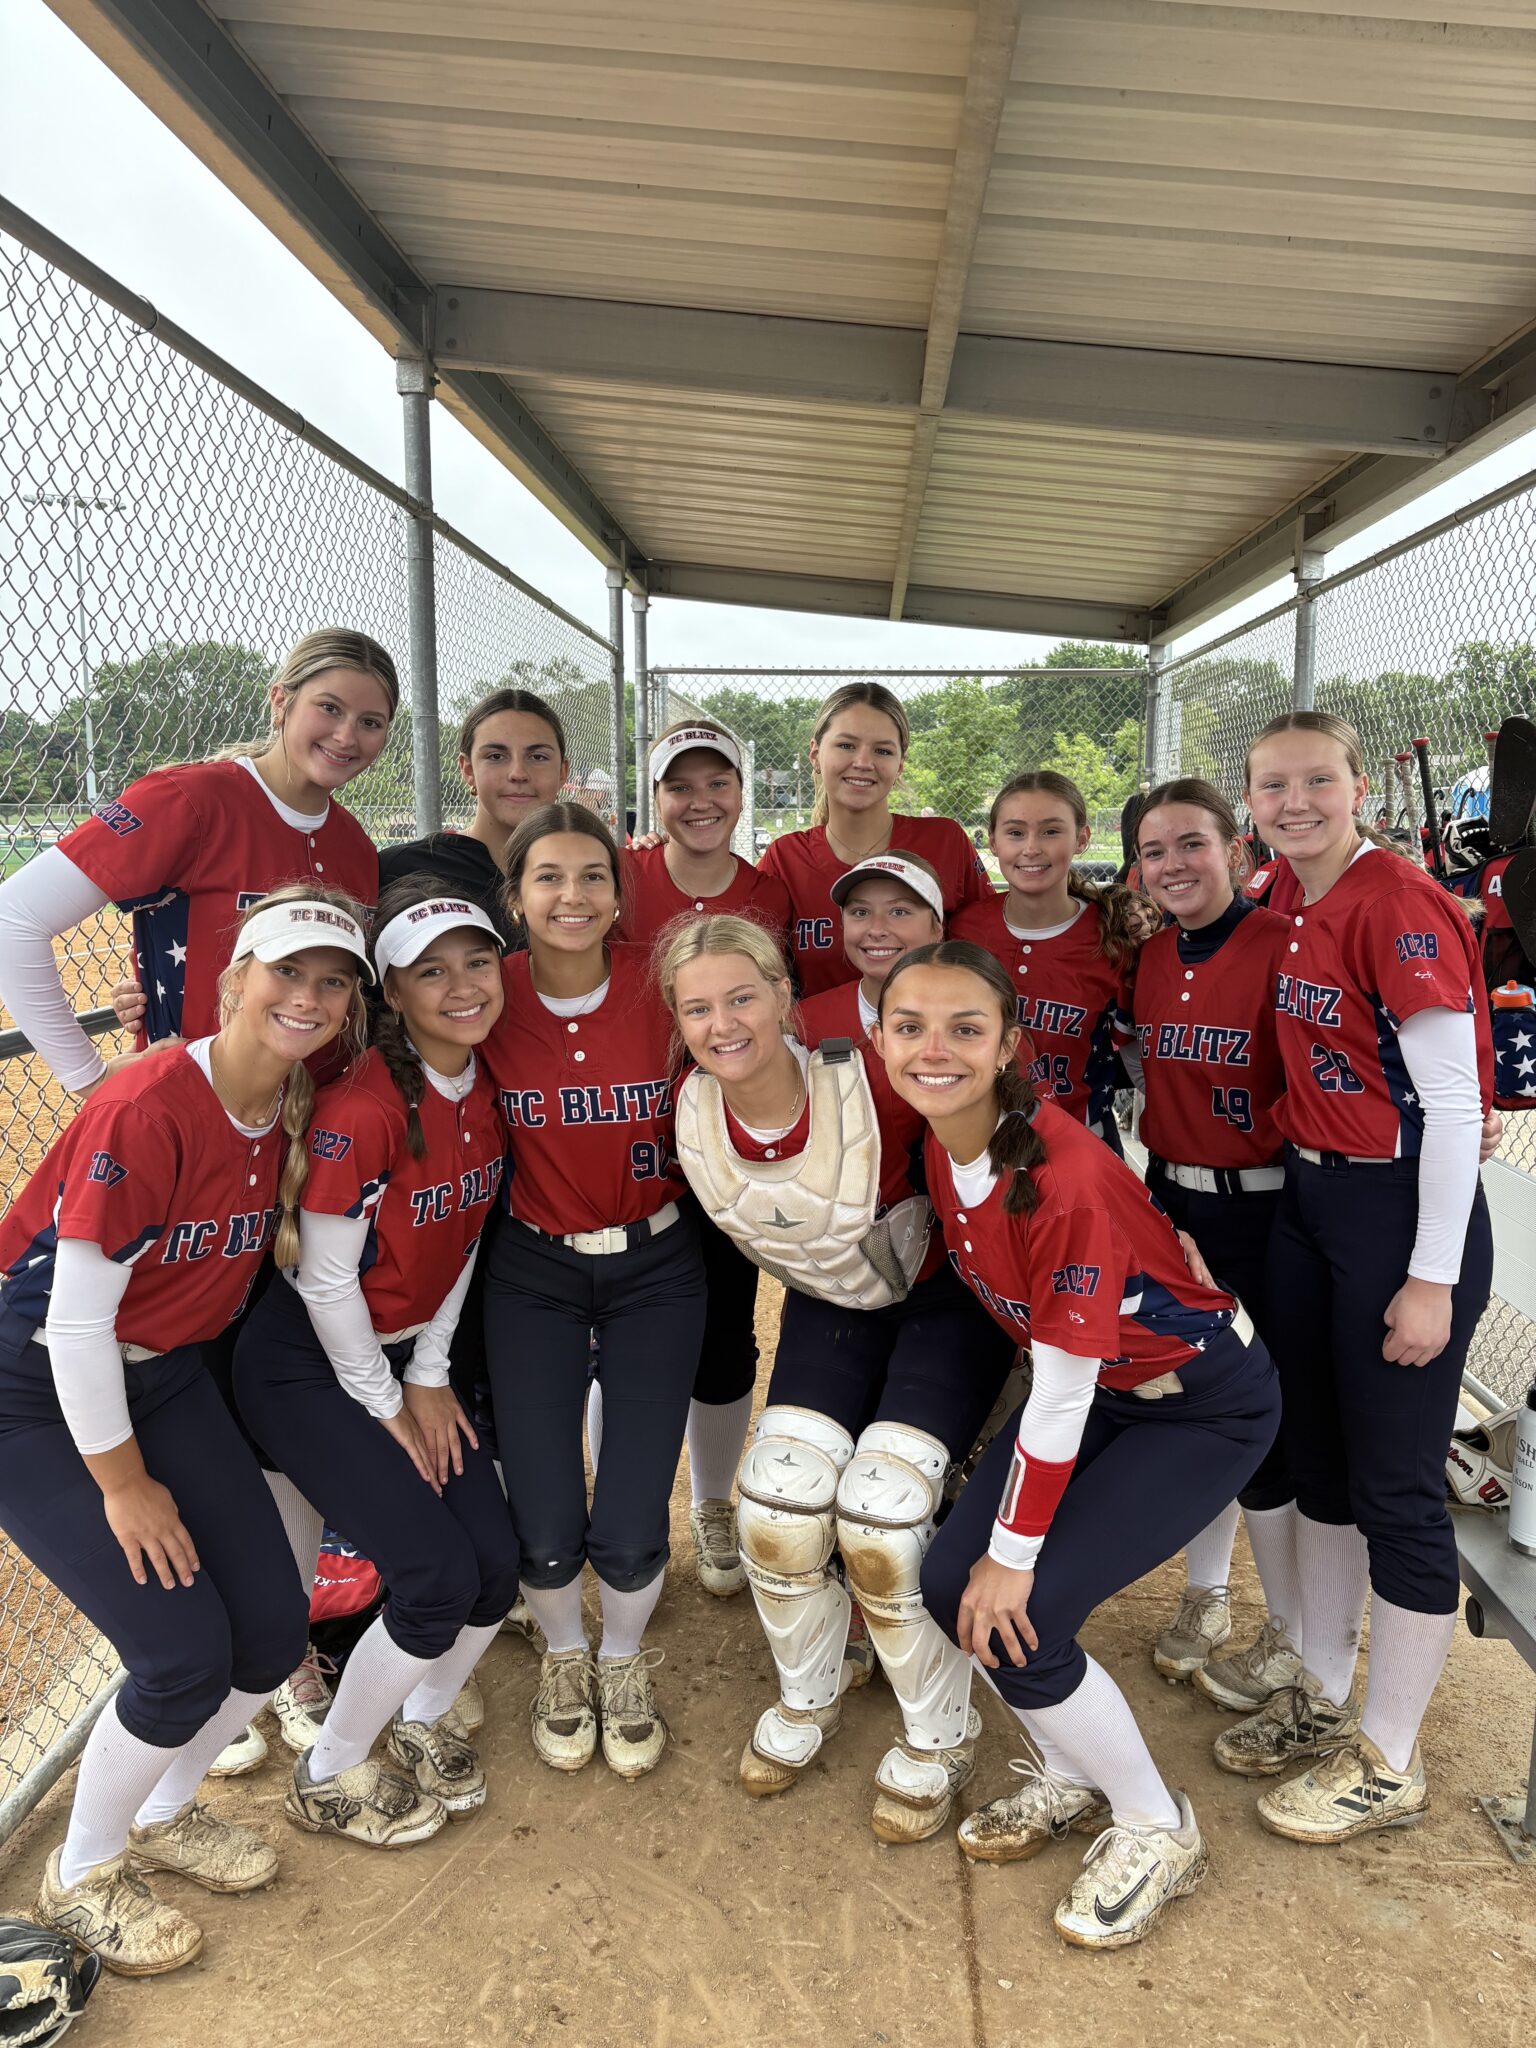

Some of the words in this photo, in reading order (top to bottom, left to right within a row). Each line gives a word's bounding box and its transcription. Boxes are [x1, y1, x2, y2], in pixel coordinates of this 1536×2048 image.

[668, 734, 684, 747] TC
[684, 731, 719, 741] BLITZ
[96, 800, 144, 837] 2027
[289, 908, 313, 922] TC
[314, 909, 357, 936] BLITZ
[407, 906, 429, 924] TC
[428, 902, 473, 915] BLITZ
[796, 918, 834, 950] TC
[1394, 932, 1439, 965] 2028
[1016, 995, 1088, 1038] LITZ
[1275, 972, 1343, 1028] BLITZ
[1156, 1023, 1252, 1067] BLITZ
[1311, 1043, 1366, 1093] 28
[500, 1088, 547, 1127] TC
[558, 1078, 673, 1125] BLITZ
[312, 1127, 354, 1162] 2027
[87, 1150, 130, 1190] 207
[410, 1182, 453, 1227] TC
[458, 1156, 504, 1212] BLIT
[161, 1220, 219, 1264] TC
[221, 1208, 279, 1258] BLI
